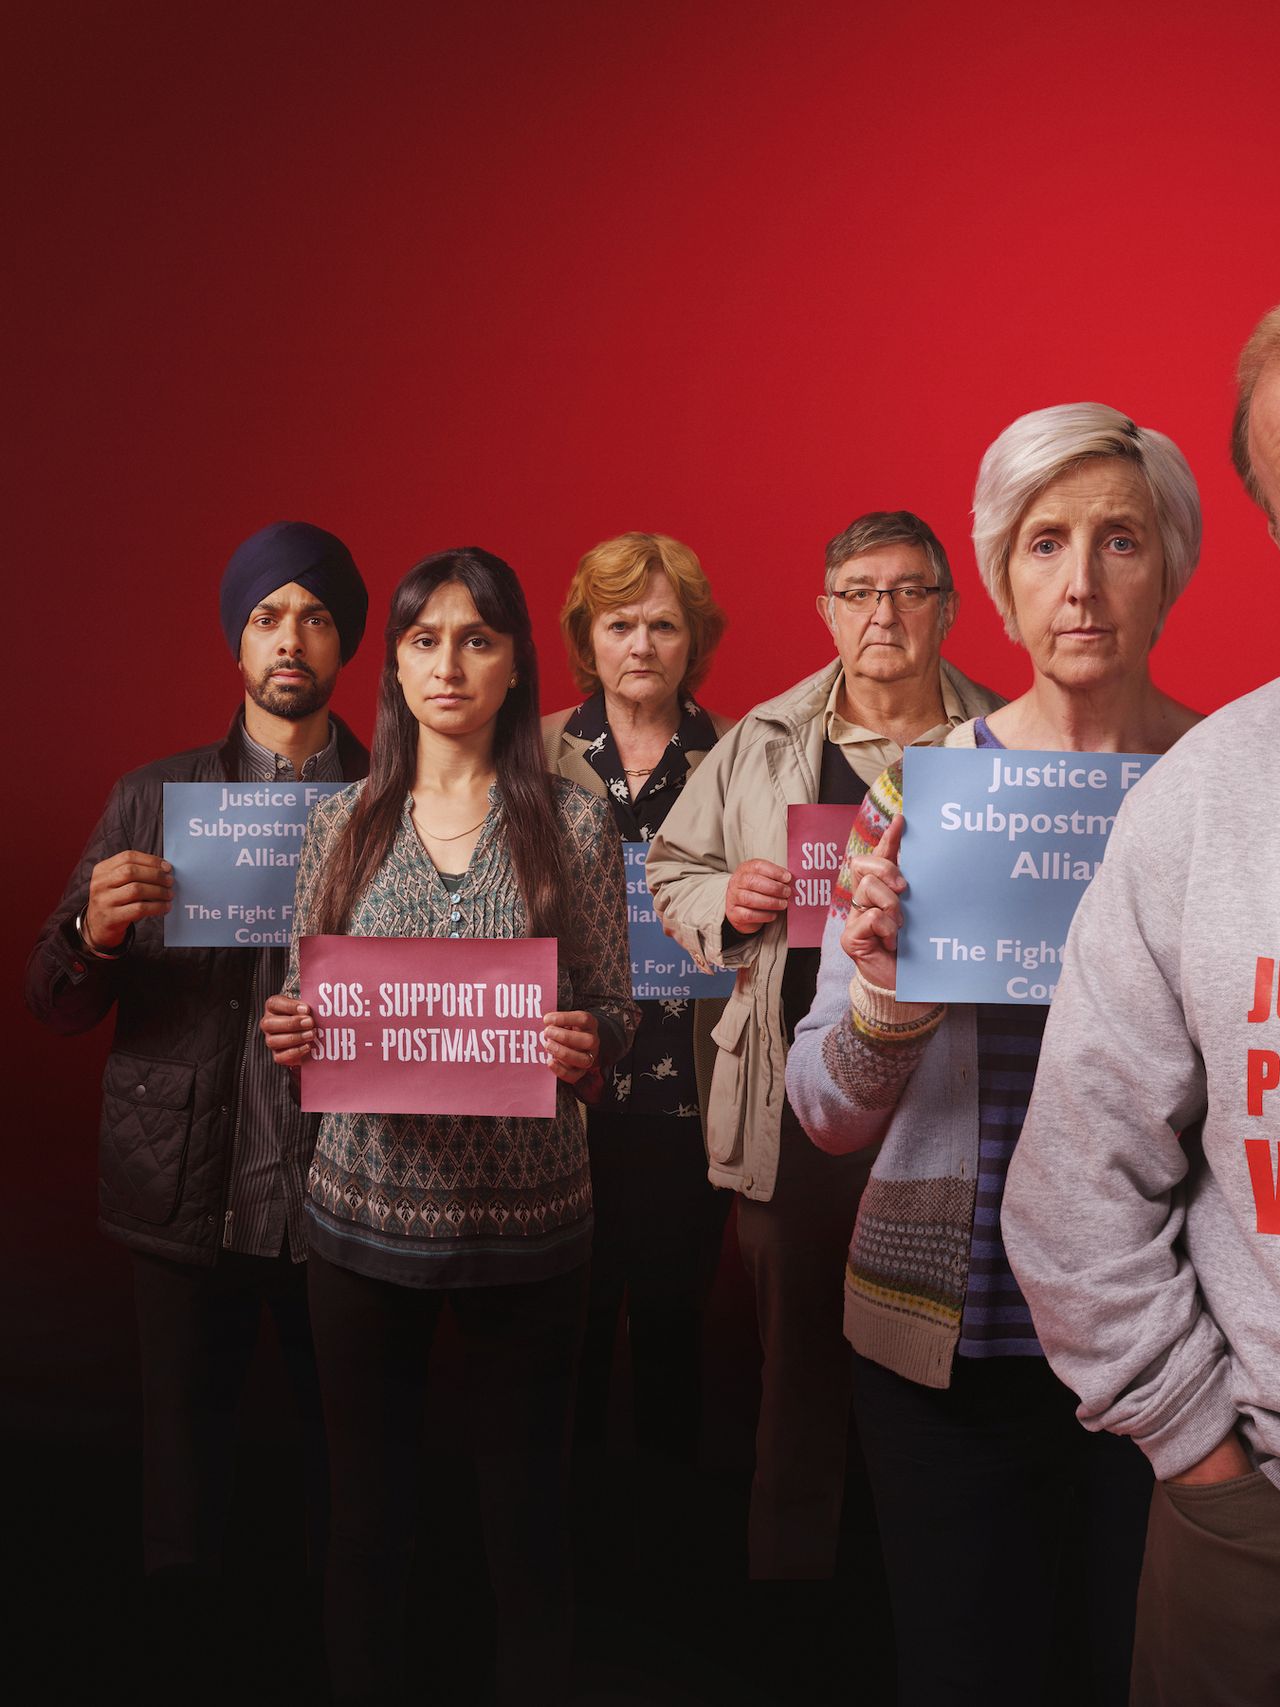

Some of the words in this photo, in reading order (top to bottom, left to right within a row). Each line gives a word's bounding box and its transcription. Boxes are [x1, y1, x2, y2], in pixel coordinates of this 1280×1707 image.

[988, 758, 1107, 793] Justice
[219, 788, 297, 811] Justice
[188, 818, 305, 842] Subpostm
[941, 802, 1118, 841] Subpostm
[235, 848, 300, 867] Allian
[802, 842, 843, 870] SOS:
[1010, 851, 1103, 881] Allia
[795, 878, 831, 906] SUB
[185, 904, 222, 920] The
[228, 904, 275, 924] Fight
[234, 928, 292, 944] Conti
[929, 937, 986, 961] The
[644, 959, 675, 974] For
[318, 982, 371, 1017] SOS:
[379, 982, 487, 1018] SUPPORT
[495, 983, 543, 1018] OUR
[311, 1028, 356, 1060] SUB
[381, 1028, 554, 1065] POSTMASTERS
